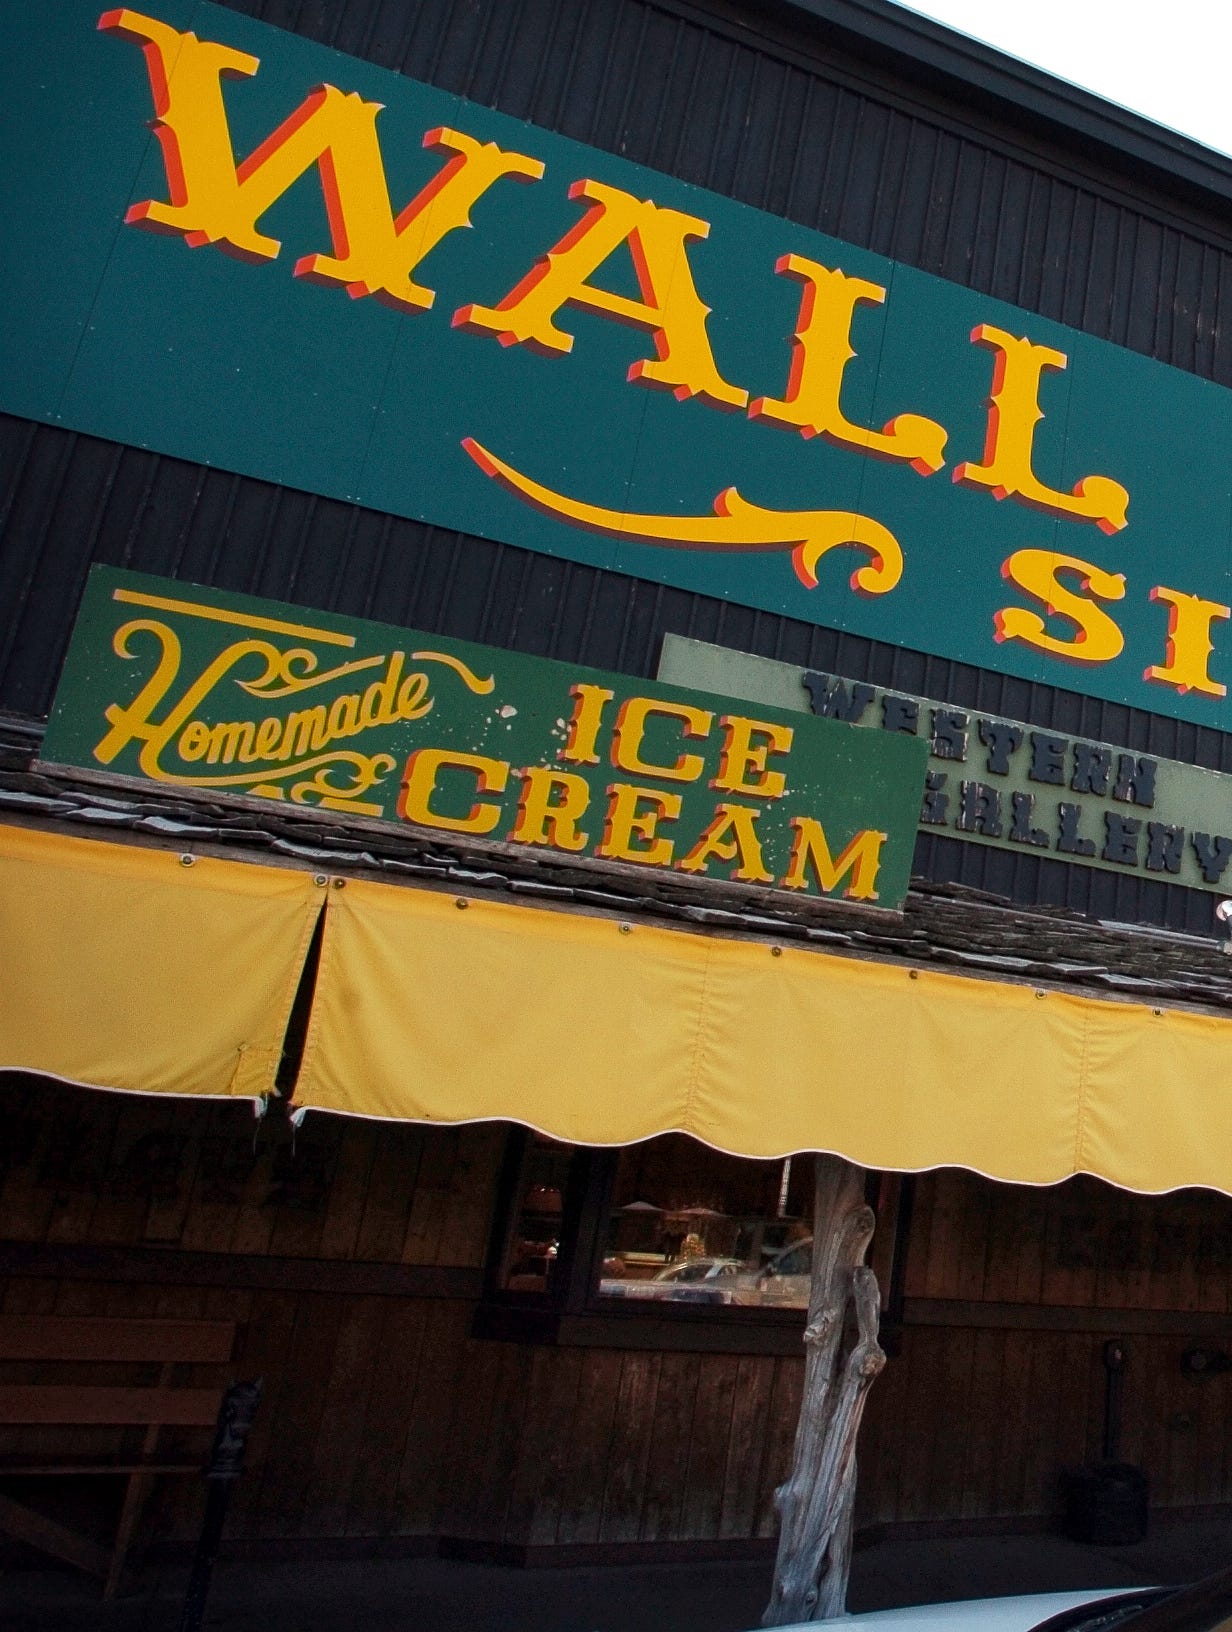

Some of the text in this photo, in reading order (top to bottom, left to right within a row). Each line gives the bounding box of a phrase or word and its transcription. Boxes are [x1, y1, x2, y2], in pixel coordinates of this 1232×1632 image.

[97, 8, 1130, 535] WALL
[93, 619, 434, 786] Homemade
[557, 684, 795, 798] ICE
[803, 672, 1158, 808] WESTERN
[397, 749, 888, 900] CREAM
